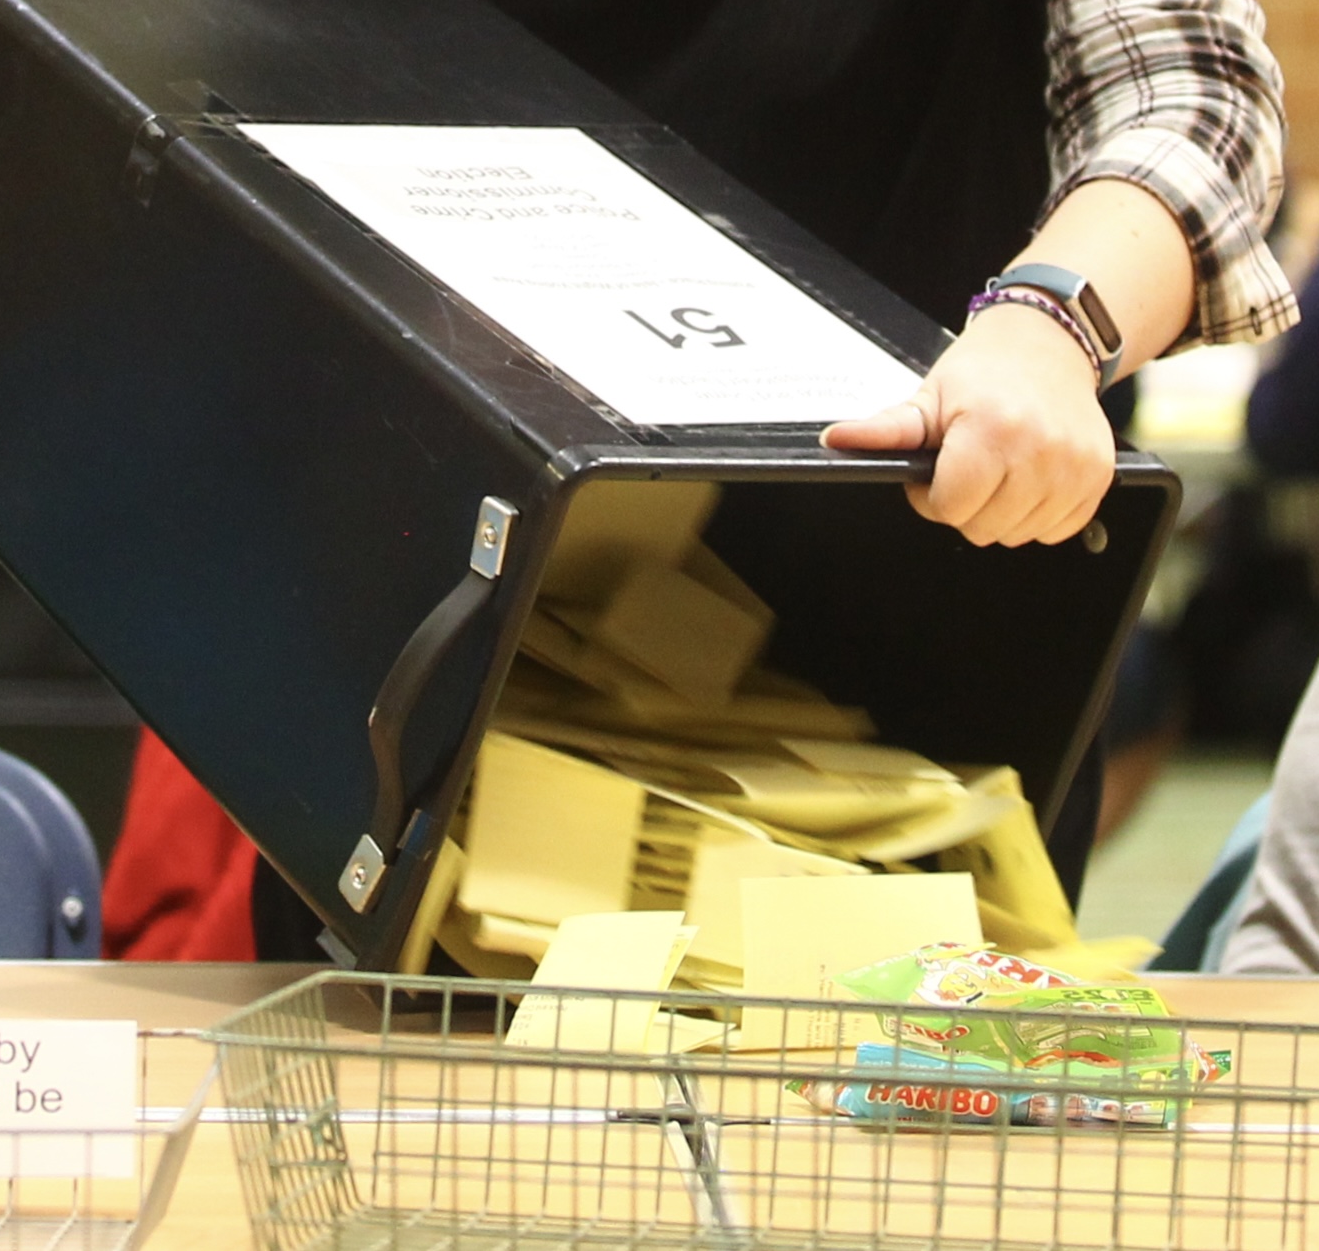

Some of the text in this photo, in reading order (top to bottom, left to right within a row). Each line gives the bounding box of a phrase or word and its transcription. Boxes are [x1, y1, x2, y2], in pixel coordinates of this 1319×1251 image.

[416, 165, 533, 182] Election
[402, 185, 598, 204] Commissioner
[409, 203, 642, 223] Police and Crime
[622, 306, 748, 350] 51
[14, 1082, 64, 1115] be
[866, 1082, 999, 1118] HARIBO
